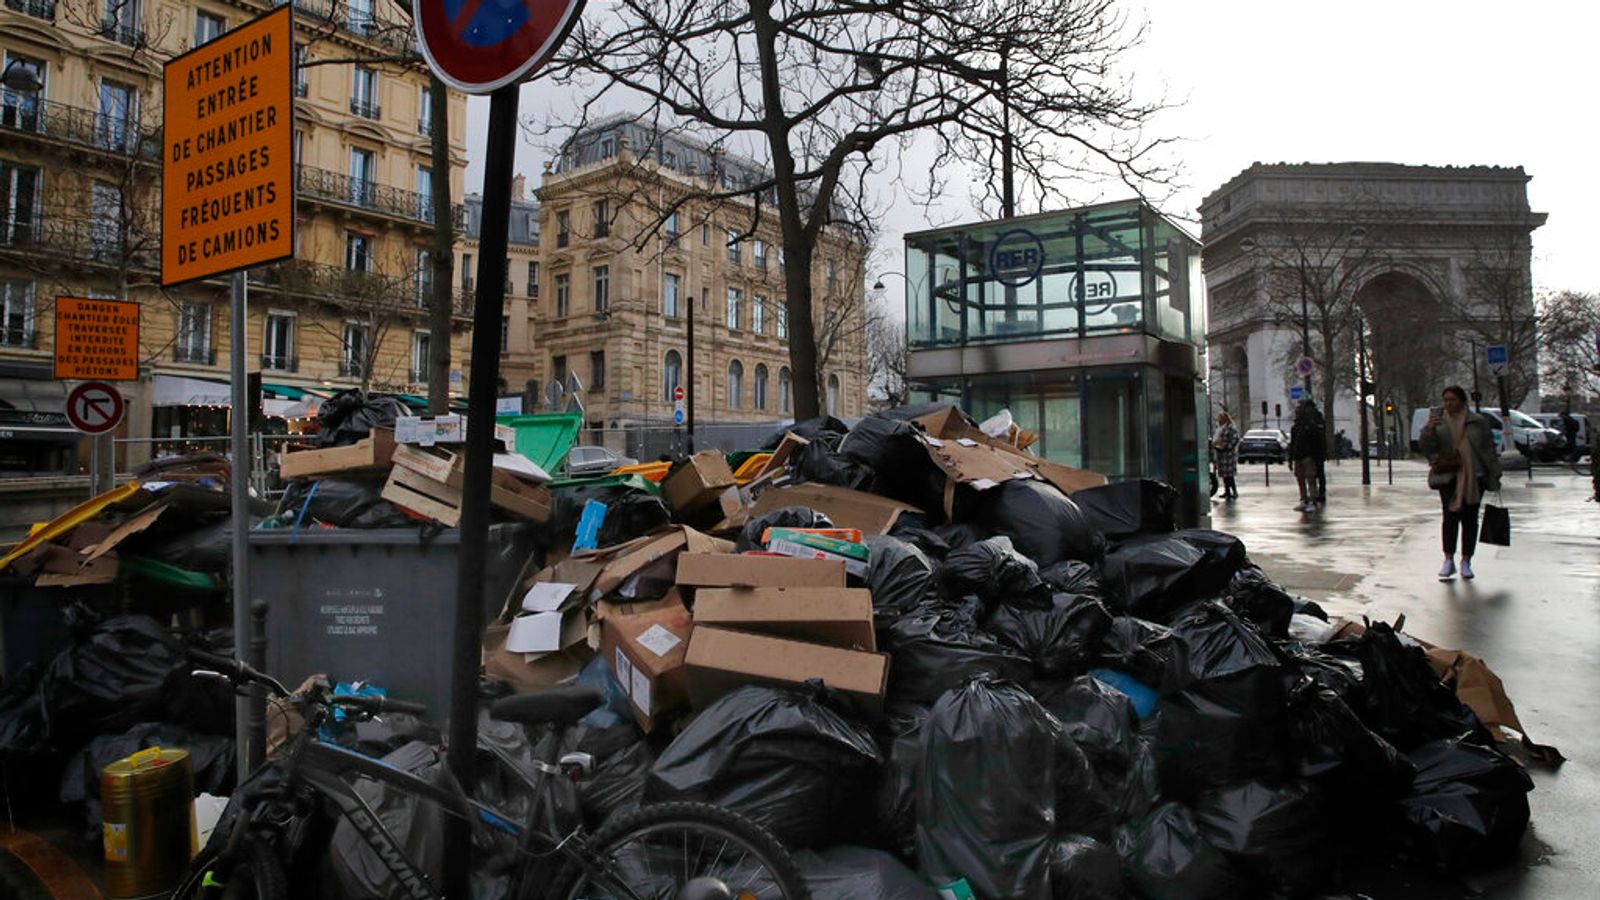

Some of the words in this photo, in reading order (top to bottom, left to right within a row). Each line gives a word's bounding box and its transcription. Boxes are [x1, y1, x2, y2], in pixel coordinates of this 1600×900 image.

[187, 32, 272, 91] ATTENTION
[196, 75, 259, 119] ENTRÉE
[172, 138, 191, 163] DE
[196, 105, 278, 154] CHANTIER
[186, 145, 271, 193] PASSAGES
[181, 181, 277, 230] FRÉQUENTS
[178, 242, 197, 266] DE
[202, 218, 280, 259] CAMIONS
[996, 248, 1038, 268] RER
[57, 312, 110, 323] CHANTIER
[77, 303, 119, 313] DANGER
[67, 344, 81, 353] EN
[84, 346, 127, 355] DEHORS
[70, 335, 125, 345] INTERDITE
[58, 355, 79, 364] DES
[82, 356, 135, 366] PASSAGES
